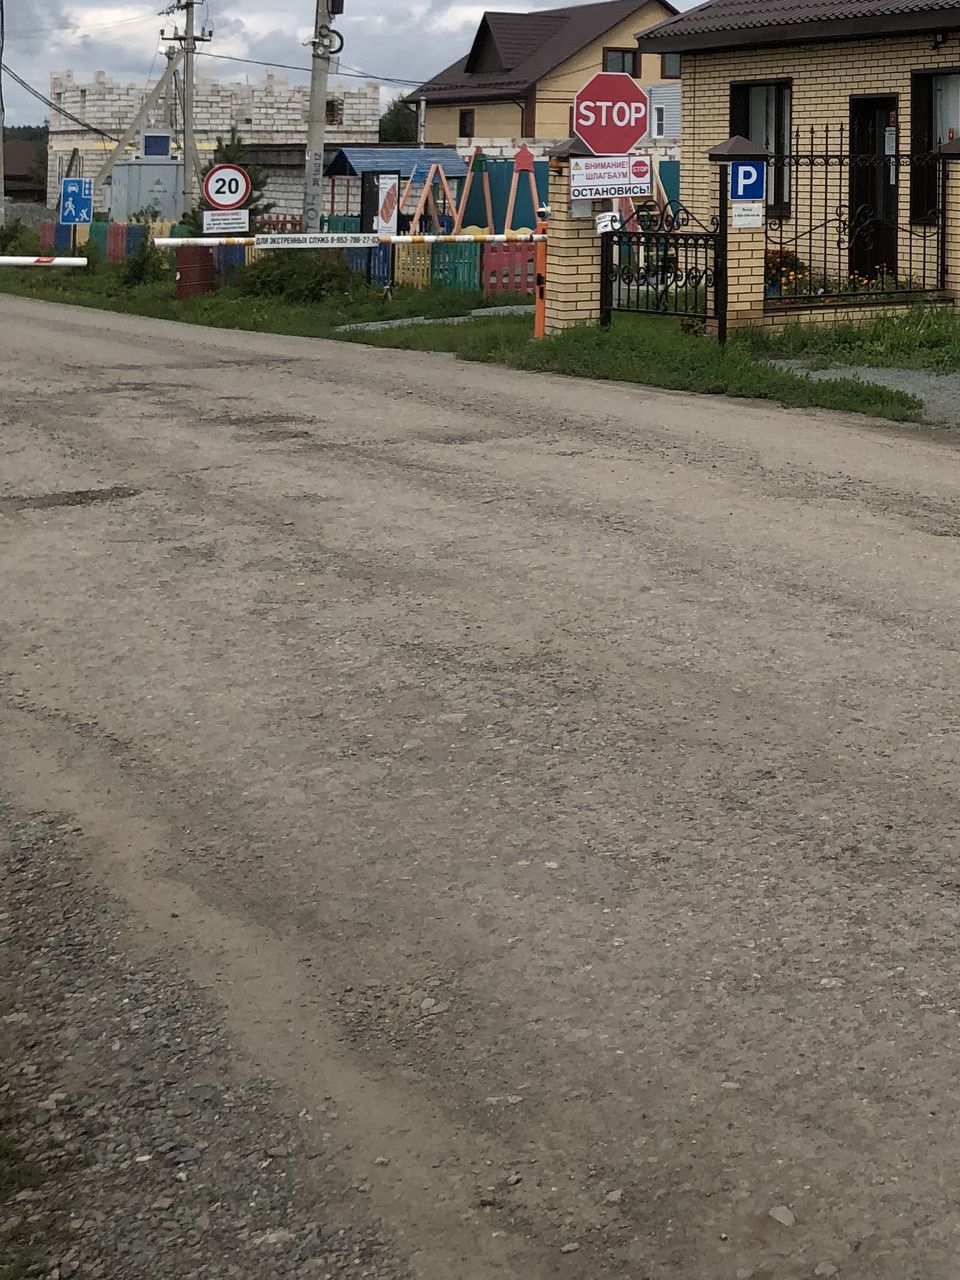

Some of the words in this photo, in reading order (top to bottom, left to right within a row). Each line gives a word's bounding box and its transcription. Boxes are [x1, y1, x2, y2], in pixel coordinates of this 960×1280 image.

[578, 101, 646, 127] STOP
[584, 161, 629, 170] ВНИМАНИЕ!
[585, 171, 628, 180] ШЛАГБАУМ
[738, 166, 757, 195] P
[214, 178, 239, 194] 20
[572, 185, 650, 197] ОСТАНОВИСЬ!
[256, 237, 268, 245] ДЛЯ
